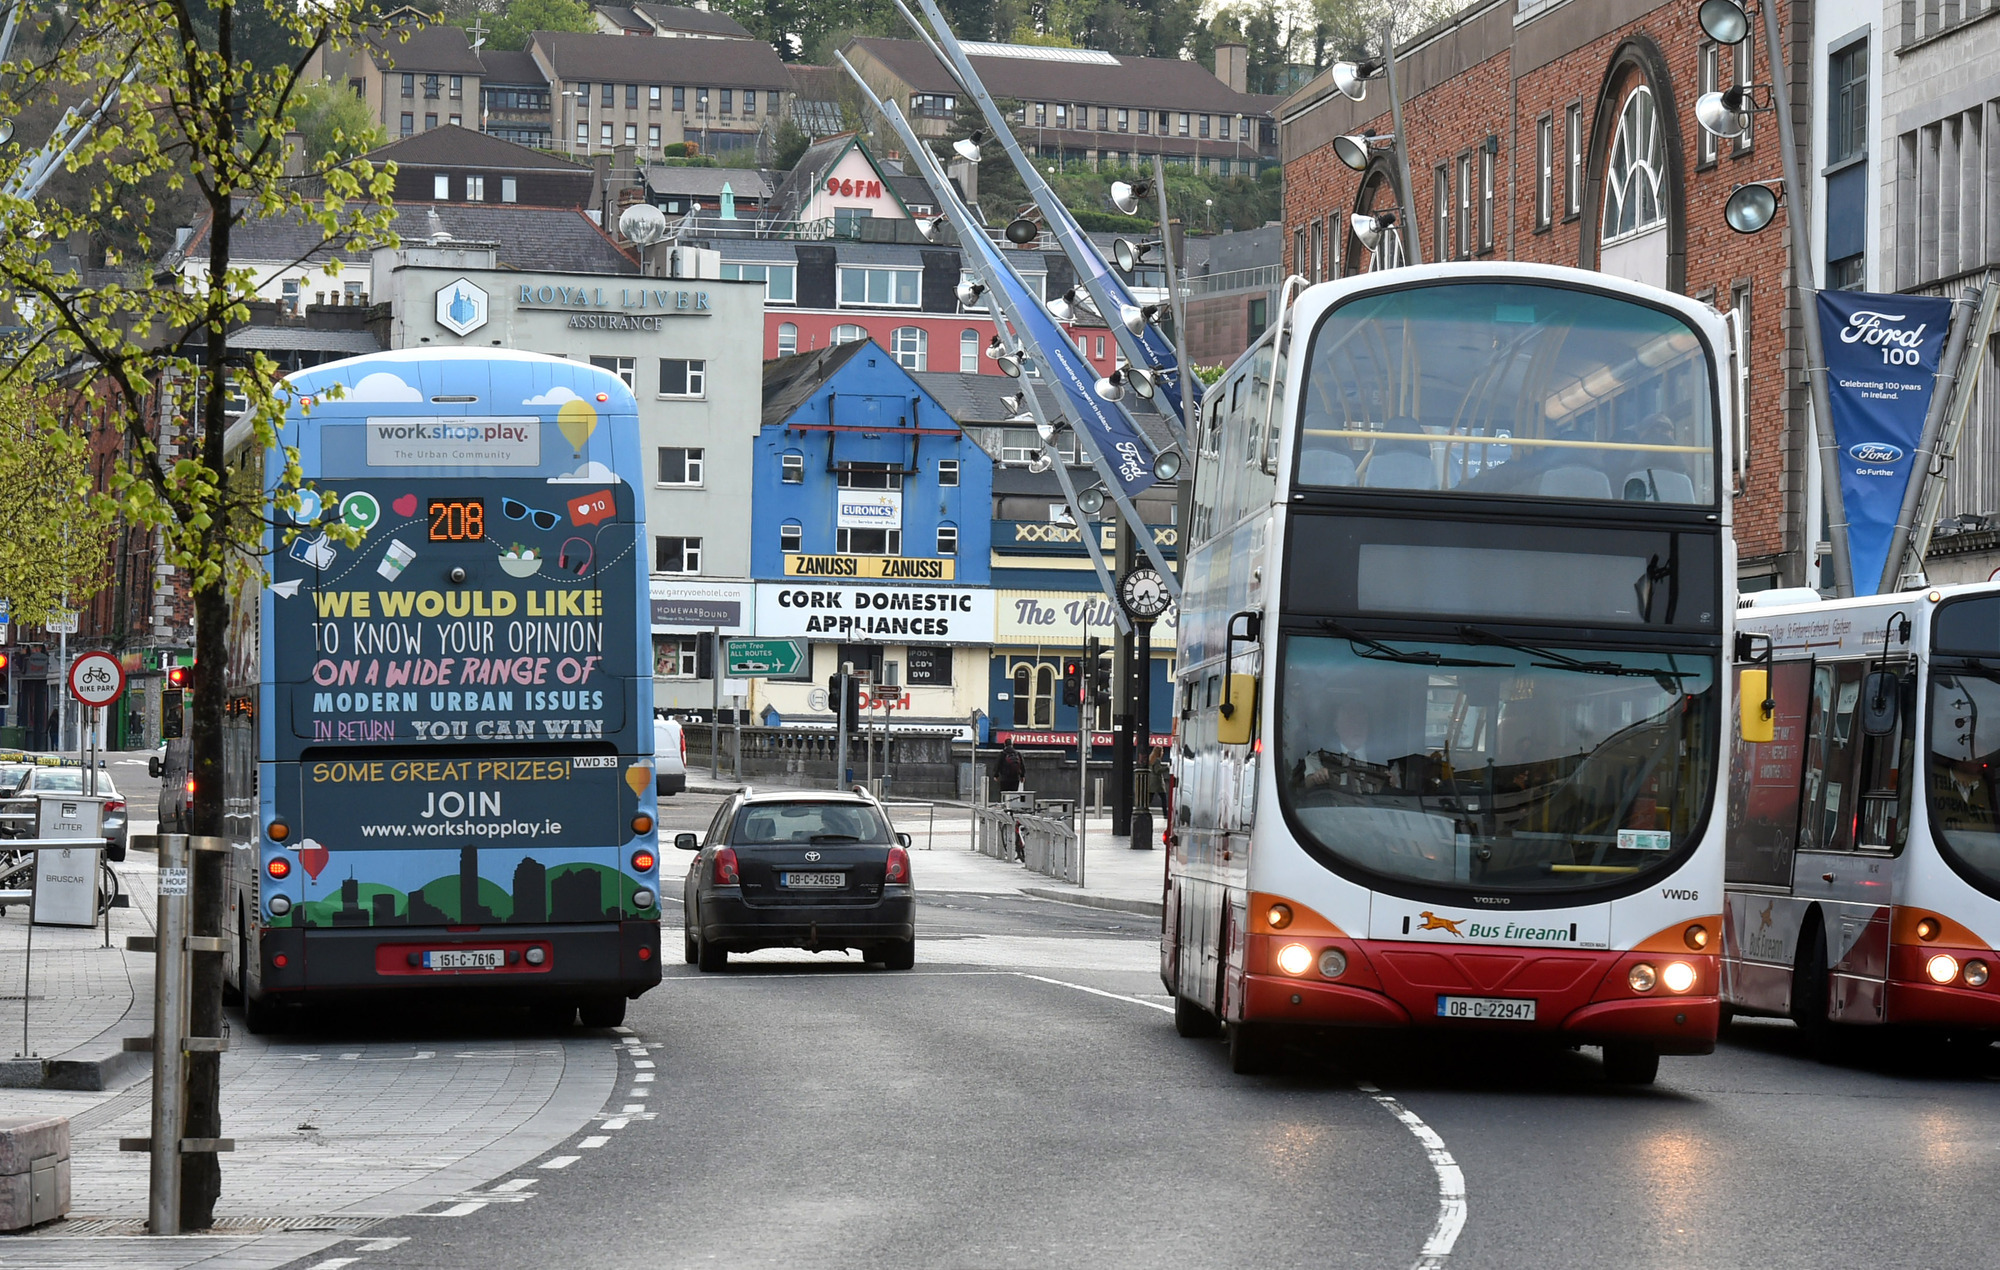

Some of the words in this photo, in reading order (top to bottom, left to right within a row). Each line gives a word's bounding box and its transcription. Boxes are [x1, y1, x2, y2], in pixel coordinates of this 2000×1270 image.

[519, 284, 610, 306] ROYAL
[622, 288, 712, 310] LIVER
[568, 314, 664, 331] ASSURANCE
[1840, 310, 1926, 348] Ford
[1054, 349, 1078, 383] Celebrating
[1881, 348, 1920, 366] 100
[1840, 380, 1884, 390] Celebrating
[1870, 392, 1898, 400] Ireland.
[395, 450, 413, 459] The
[417, 450, 448, 459] Urban
[452, 450, 511, 460] Community
[1116, 441, 1148, 478] Ford
[1858, 445, 1892, 461] Ford
[1118, 464, 1134, 482] 100
[592, 500, 606, 512] 10
[844, 505, 891, 516] EURONICS
[430, 502, 483, 540] 208
[796, 557, 858, 576] ZANUSSI
[882, 559, 943, 578] ZANUSSI
[312, 591, 370, 618] WE
[378, 590, 517, 618] WOULD
[526, 590, 603, 616] LIKE
[778, 590, 842, 608] CORK
[855, 592, 972, 612] DOMESTIC
[1015, 599, 1056, 626] The
[806, 616, 948, 636] APPLIANCES
[312, 622, 339, 654] TO
[353, 621, 422, 655] KNOW
[437, 621, 494, 655] YOUR
[508, 620, 603, 654] OPINION
[312, 658, 360, 686] ON
[364, 658, 379, 686] A
[385, 658, 455, 688] WIDE
[460, 656, 550, 686] RANGE
[556, 656, 602, 685] OF
[312, 692, 418, 712] MODERN
[430, 691, 513, 712] URBAN
[526, 690, 604, 711] ISSUES
[859, 692, 910, 710] OSCH
[312, 720, 333, 742] IN
[338, 720, 395, 742] RETURN
[412, 720, 468, 741] YOU
[475, 720, 535, 740] CAN
[543, 720, 604, 740] WIN
[1010, 734, 1049, 743] VINTAGE
[1050, 734, 1070, 744] SALE
[1073, 736, 1095, 744] NW
[1098, 736, 1112, 744] ON
[312, 762, 384, 782] SOME
[390, 761, 472, 782] GREAT
[478, 760, 571, 781] PRIZES!
[574, 758, 600, 767] VWD
[603, 758, 616, 766] 35
[420, 791, 501, 818] JOIN
[361, 819, 562, 838] www.workshopplay.ie
[46, 874, 84, 883] BRUSCAR
[789, 874, 841, 885] 08-C-24659
[1473, 896, 1510, 904] VOLVO
[1662, 888, 1698, 901] VWD6
[1468, 924, 1500, 938] Bus
[440, 953, 496, 966] 151-C-7616
[1450, 1001, 1530, 1020] 08-C-22947
